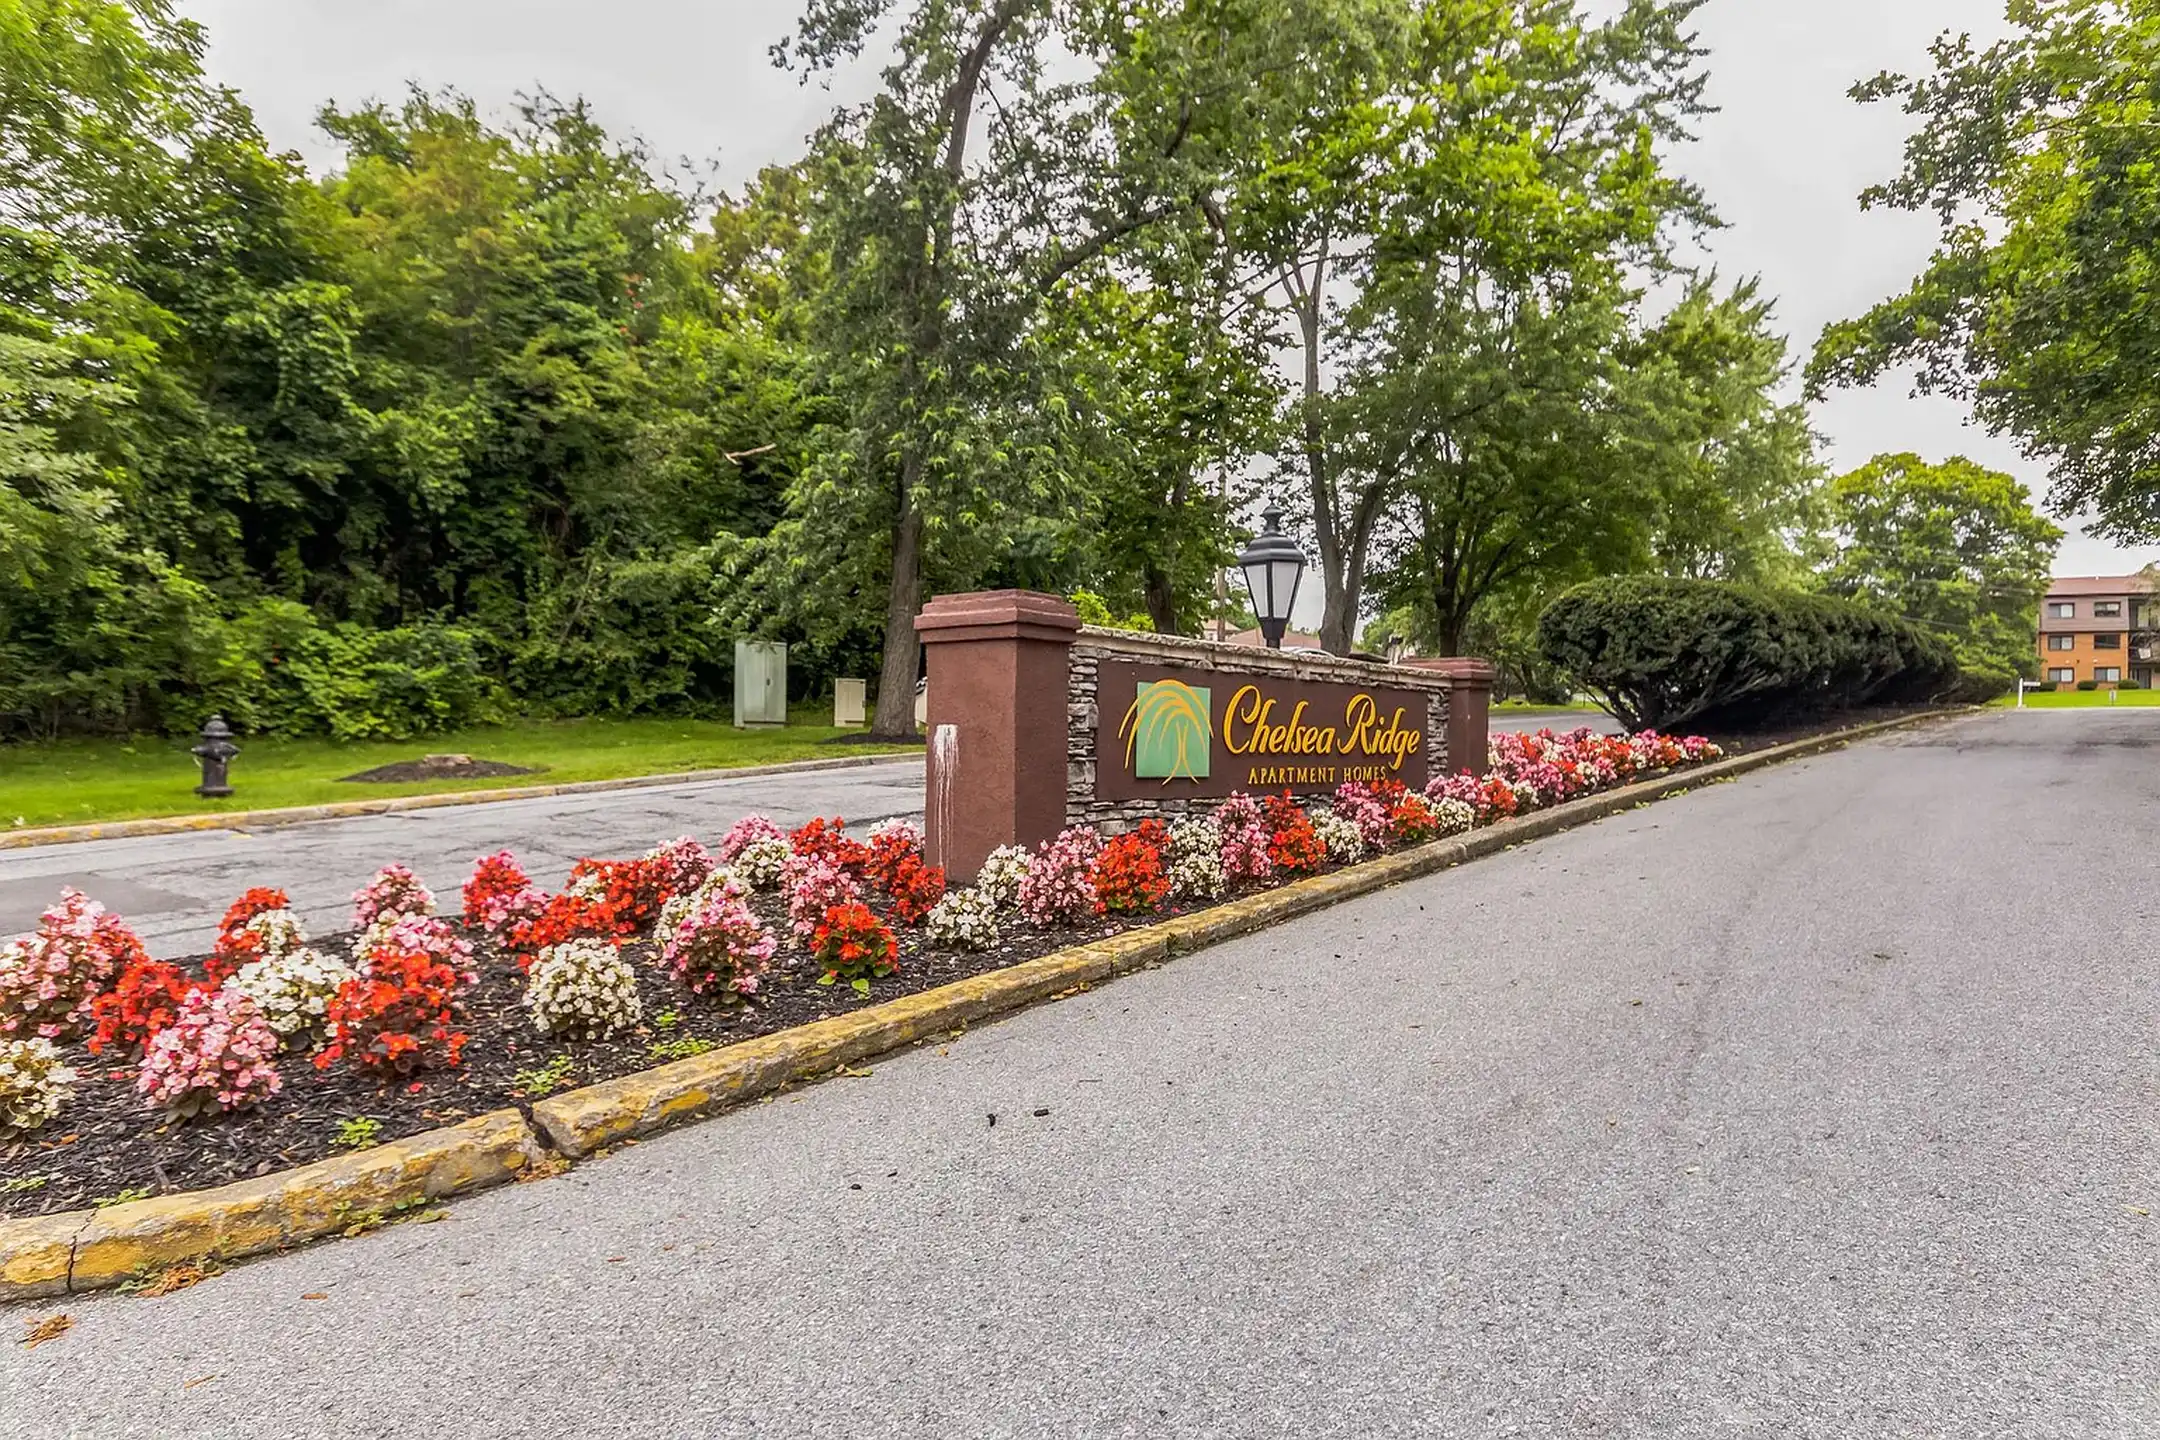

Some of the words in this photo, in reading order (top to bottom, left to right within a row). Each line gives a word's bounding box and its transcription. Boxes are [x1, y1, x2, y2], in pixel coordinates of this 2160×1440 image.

[1223, 685, 1336, 754] Chelsea
[1337, 693, 1421, 771] Ridge
[1248, 766, 1336, 785] APARTMENT
[1343, 766, 1386, 782] HOMES
